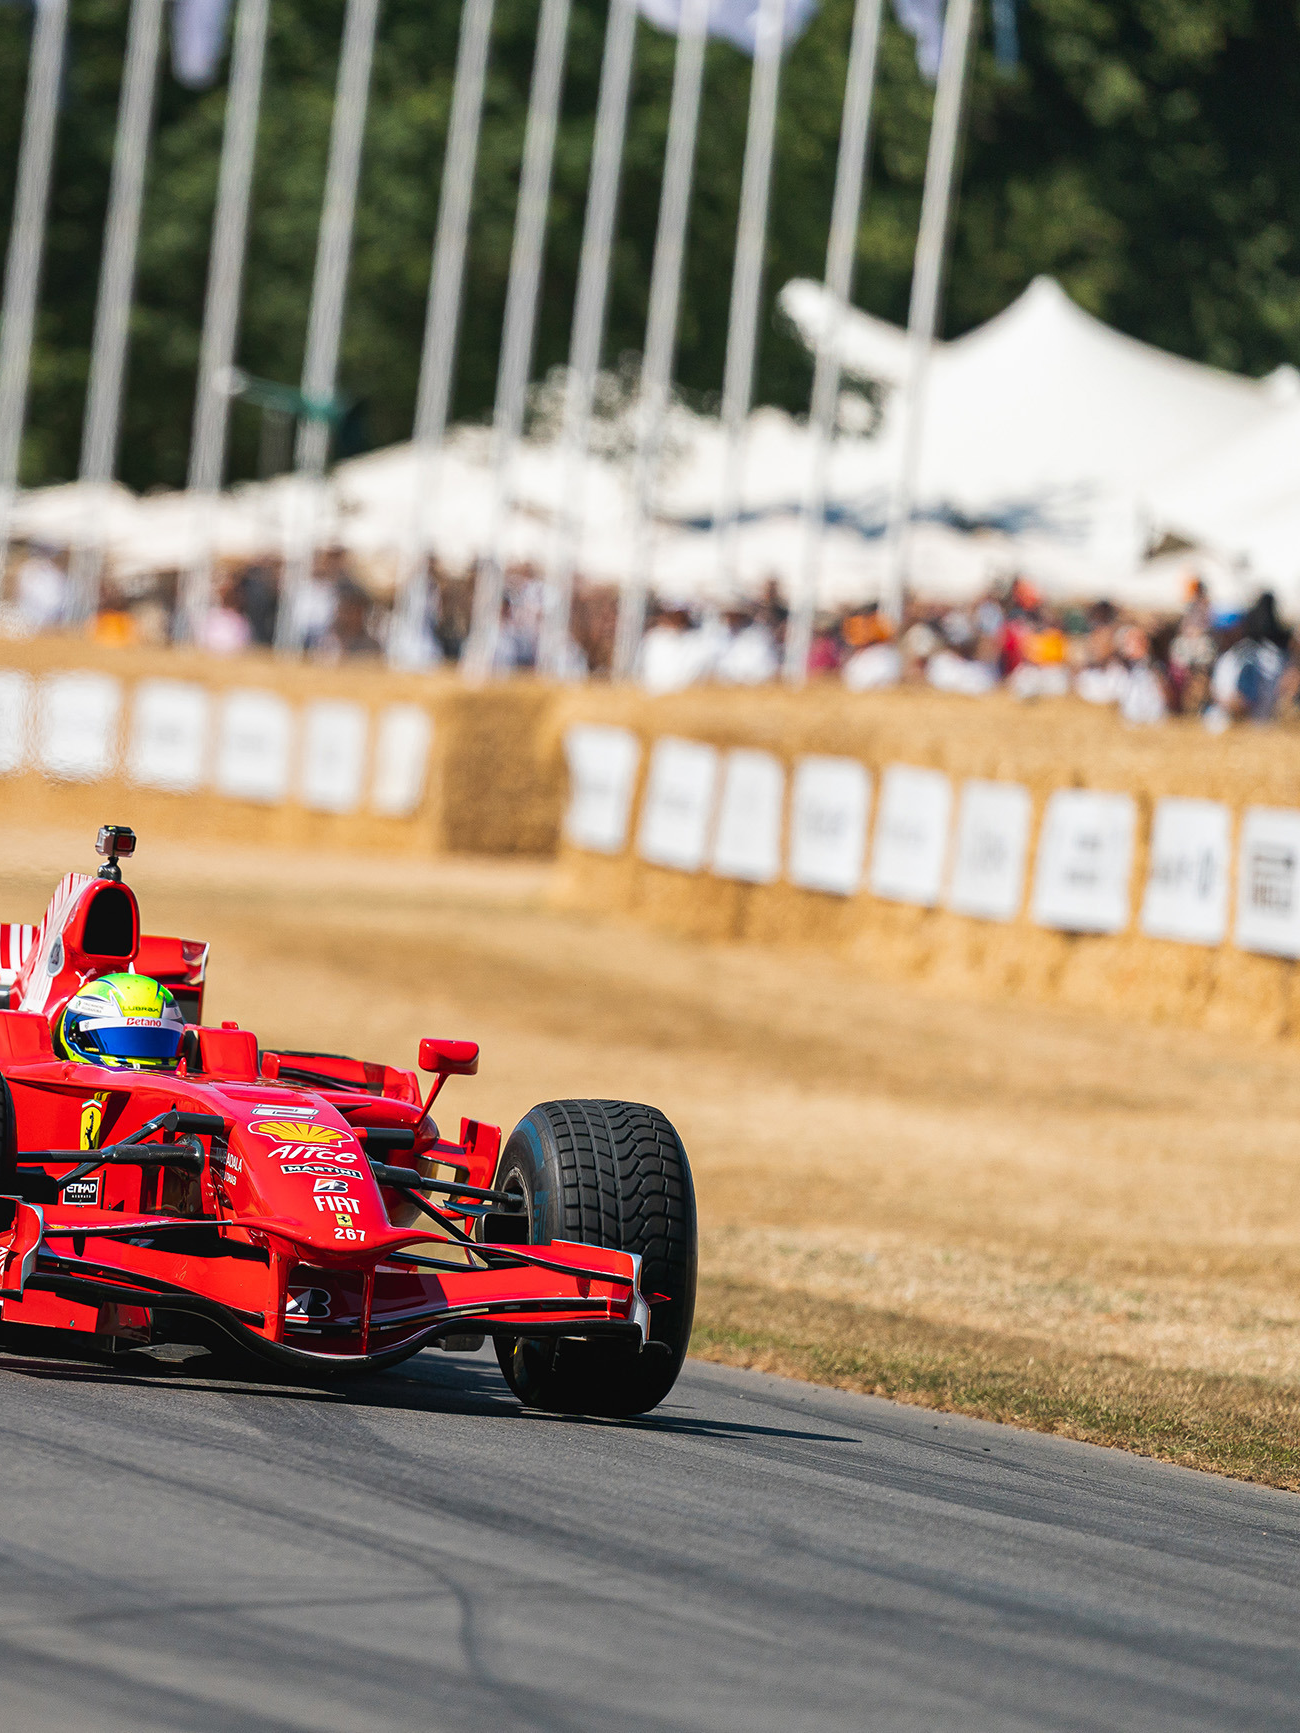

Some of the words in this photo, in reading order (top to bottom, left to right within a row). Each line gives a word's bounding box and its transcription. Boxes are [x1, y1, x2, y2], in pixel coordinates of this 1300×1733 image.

[126, 1017, 162, 1028] Betano
[287, 1165, 358, 1178] MARTINI
[66, 1183, 97, 1193] ETIHAD
[313, 1195, 360, 1214] FIAT
[333, 1227, 366, 1242] 267
